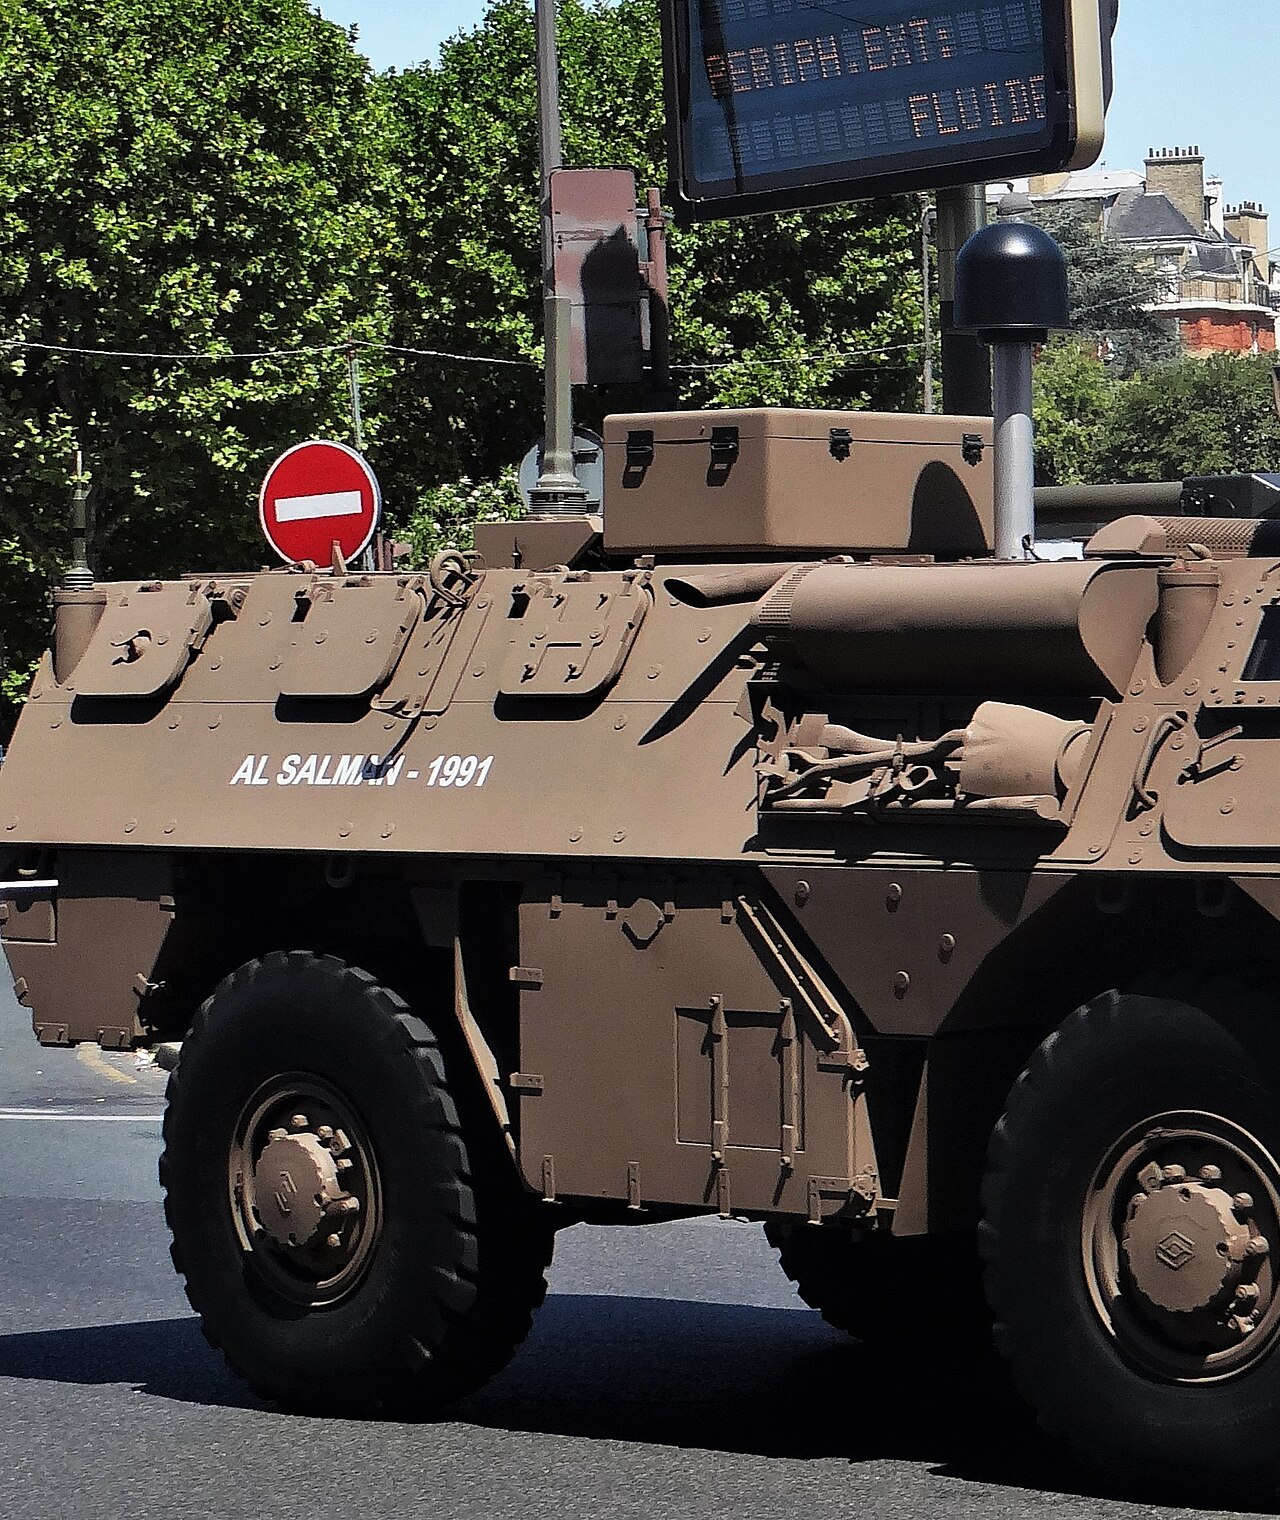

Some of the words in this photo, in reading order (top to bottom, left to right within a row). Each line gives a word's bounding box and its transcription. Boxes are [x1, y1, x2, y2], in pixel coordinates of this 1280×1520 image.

[908, 75, 1046, 138] FLUIDE
[229, 754, 269, 785] AL
[276, 754, 405, 787] SALMAN
[426, 754, 495, 788] 1991
